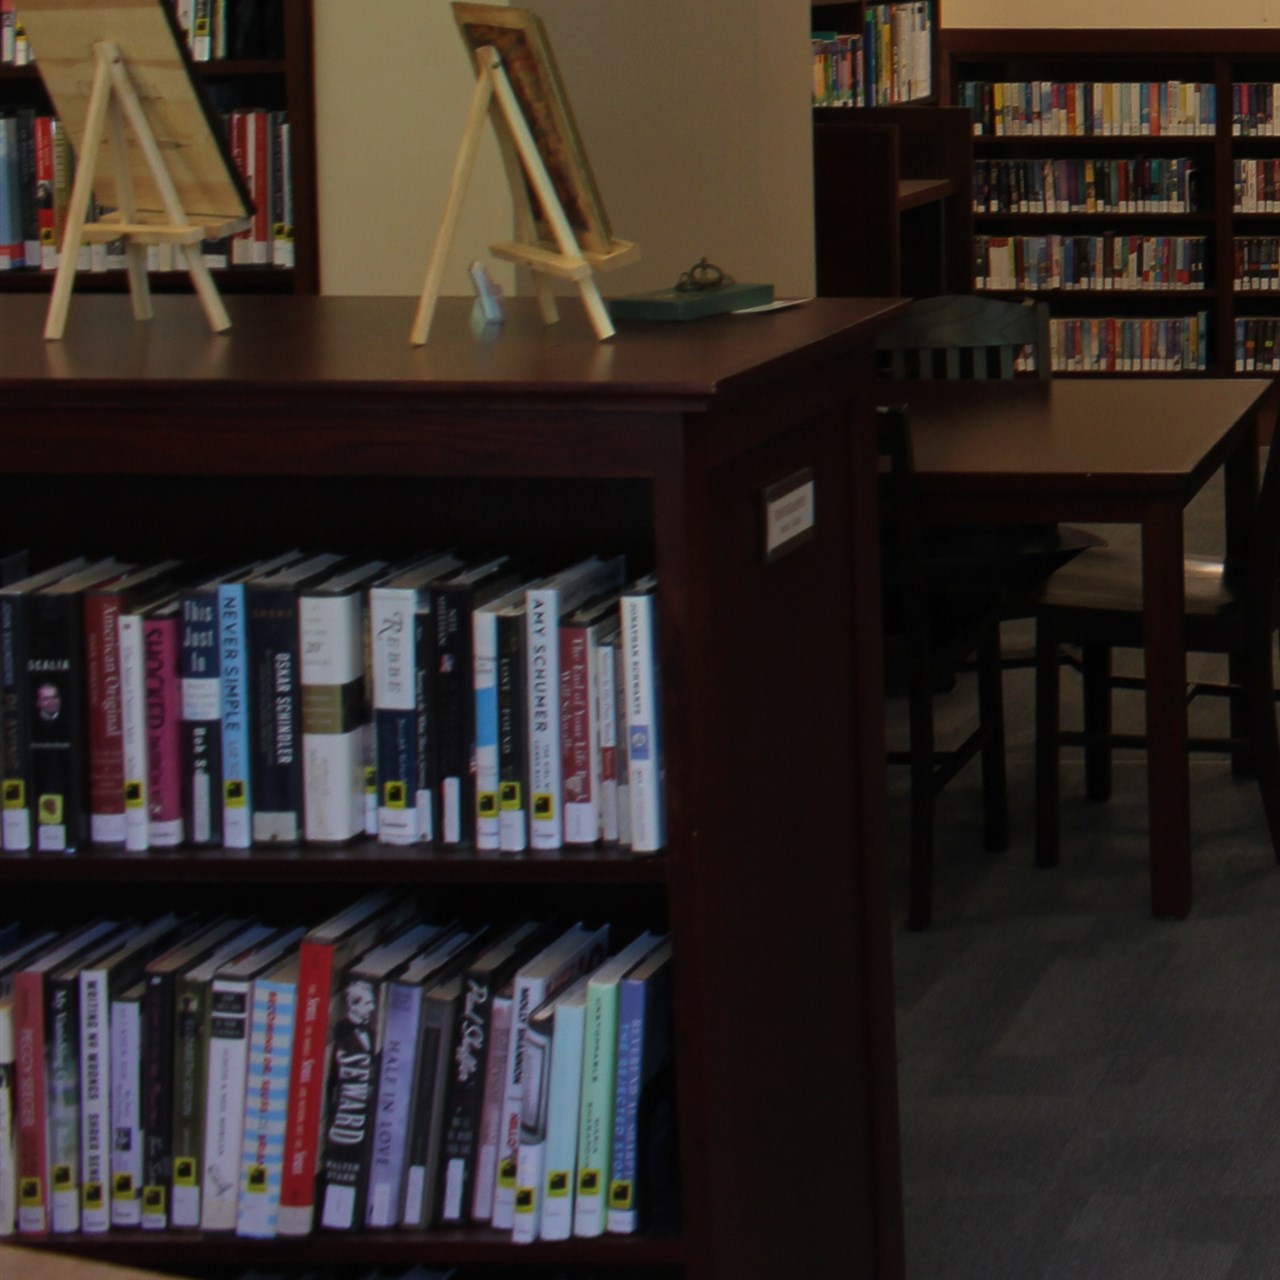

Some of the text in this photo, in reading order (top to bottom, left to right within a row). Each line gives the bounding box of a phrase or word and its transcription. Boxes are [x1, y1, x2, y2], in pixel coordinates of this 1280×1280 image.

[102, 604, 119, 673] American
[183, 626, 214, 648] Just
[184, 600, 213, 622] This
[630, 603, 640, 658] JONATHAN
[26, 659, 71, 672] SCALIA
[145, 628, 166, 730] SHOCKED
[190, 651, 207, 672] In
[223, 596, 241, 732] NEVER SIMPLE
[532, 599, 548, 733] AMY SCHUMER
[102, 675, 124, 737] Original
[274, 653, 294, 766] OSKAR SCHINDLER
[500, 658, 513, 755] LOST FOUND
[572, 639, 586, 766] The End of Your Life
[52, 989, 67, 1007] My
[264, 992, 277, 1054] BECOMING
[21, 1028, 34, 1073] PEGGY
[86, 980, 100, 1150] WRITING MY WRONGS SHAKA
[182, 1018, 194, 1116] ELIZABETH SETON
[262, 1057, 272, 1076] DR.
[508, 987, 531, 1148] MOLLY SHANNON HELLO
[616, 1024, 628, 1132] THE REJECTED
[628, 1019, 641, 1118] REVEREND AL
[23, 1078, 35, 1127] SEEGER
[258, 1080, 270, 1113] SEUSS
[328, 1050, 371, 1144] SEWARD
[376, 1040, 401, 1168] HALF IN LOVE
[326, 1160, 361, 1172] WALTER
[326, 1172, 356, 1181] STAHR
